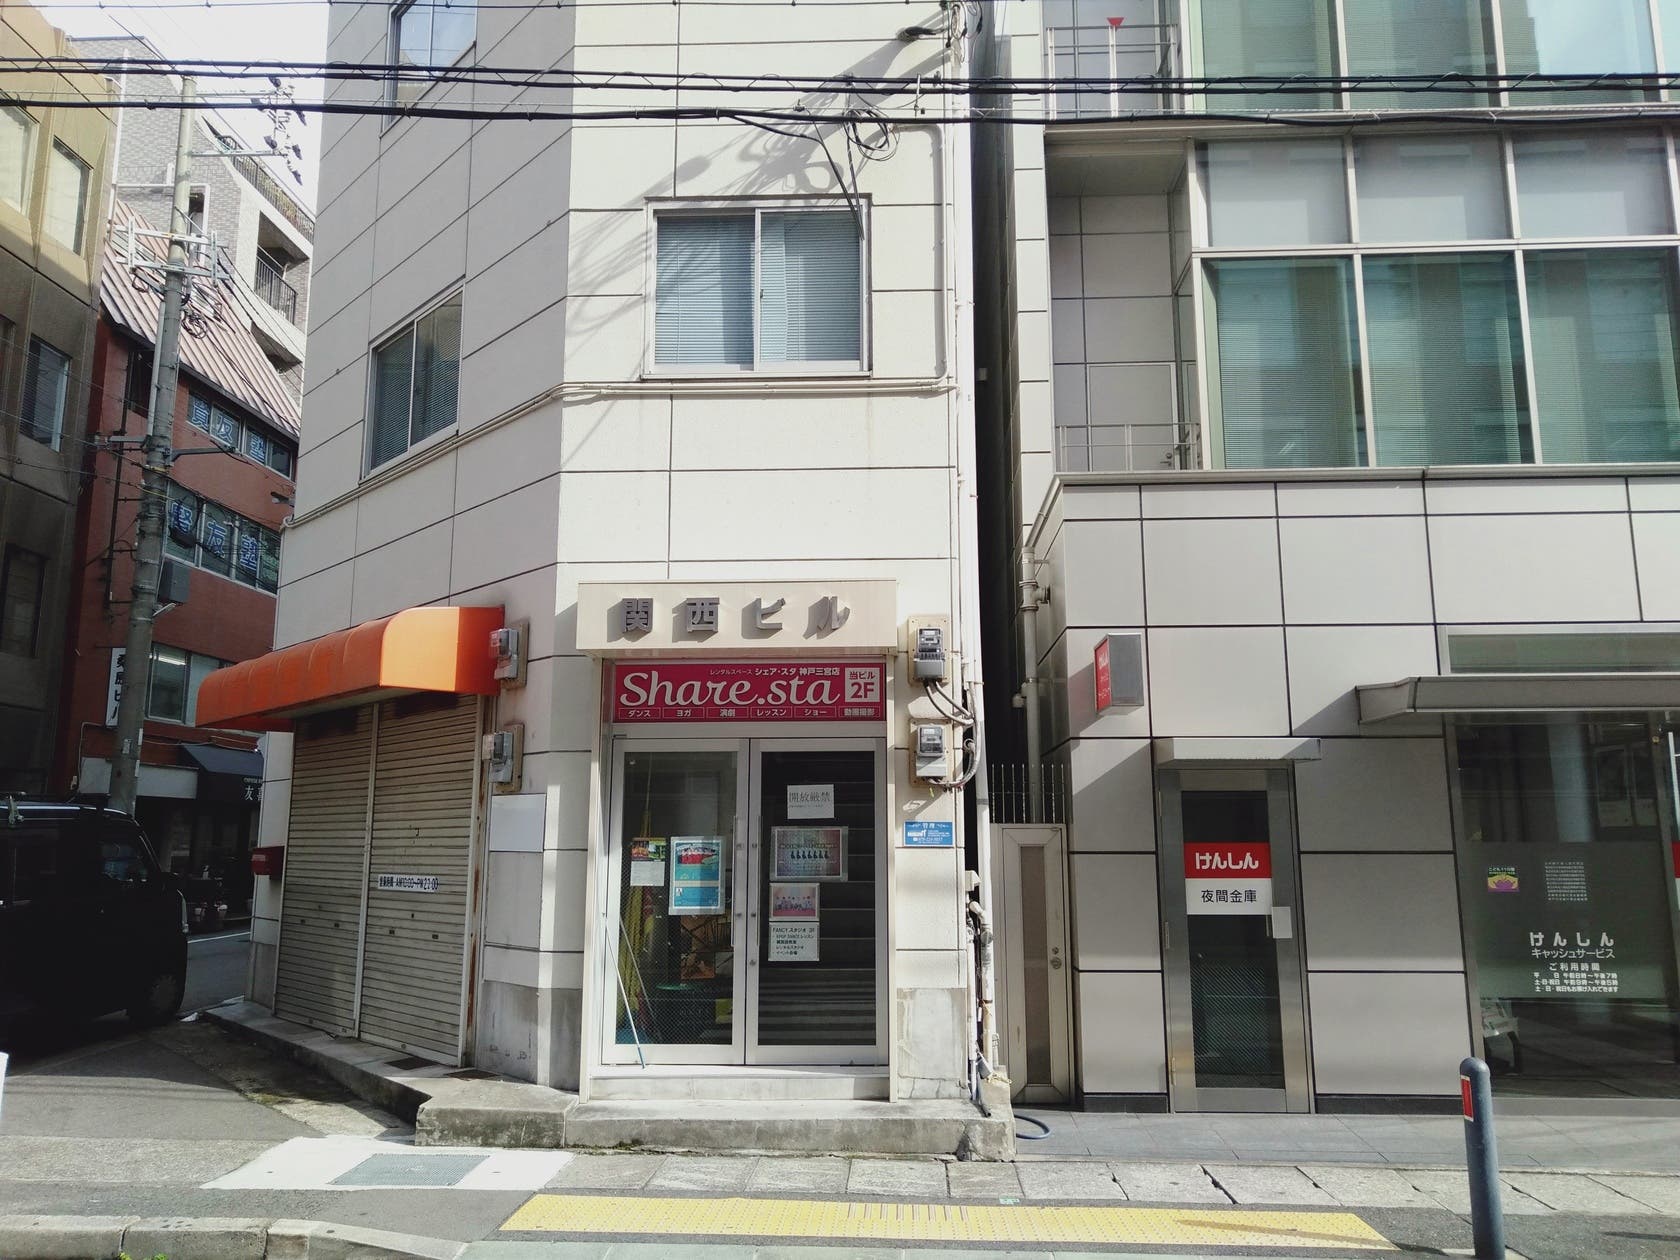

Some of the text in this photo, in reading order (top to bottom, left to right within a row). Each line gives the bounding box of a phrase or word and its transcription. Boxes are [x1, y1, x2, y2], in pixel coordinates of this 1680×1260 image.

[622, 596, 850, 632] 関西ビル
[755, 667, 796, 676] シェア・スタ
[799, 667, 840, 676] 神戸三宮店
[849, 670, 875, 680] 当ビル
[619, 671, 840, 706] Share.sta
[850, 682, 875, 699] 2F
[628, 709, 651, 718] ダンス
[676, 709, 692, 718] ヨガ
[720, 709, 735, 718] 演劇
[757, 709, 787, 718] レッスン
[804, 709, 827, 717] ショー
[1195, 852, 1259, 870] けんしん
[1201, 889, 1257, 903] 夜間金庫
[1529, 932, 1614, 947] けんしん
[1531, 948, 1616, 959] キャッシュサービス
[1549, 962, 1600, 971] ご利用時間
